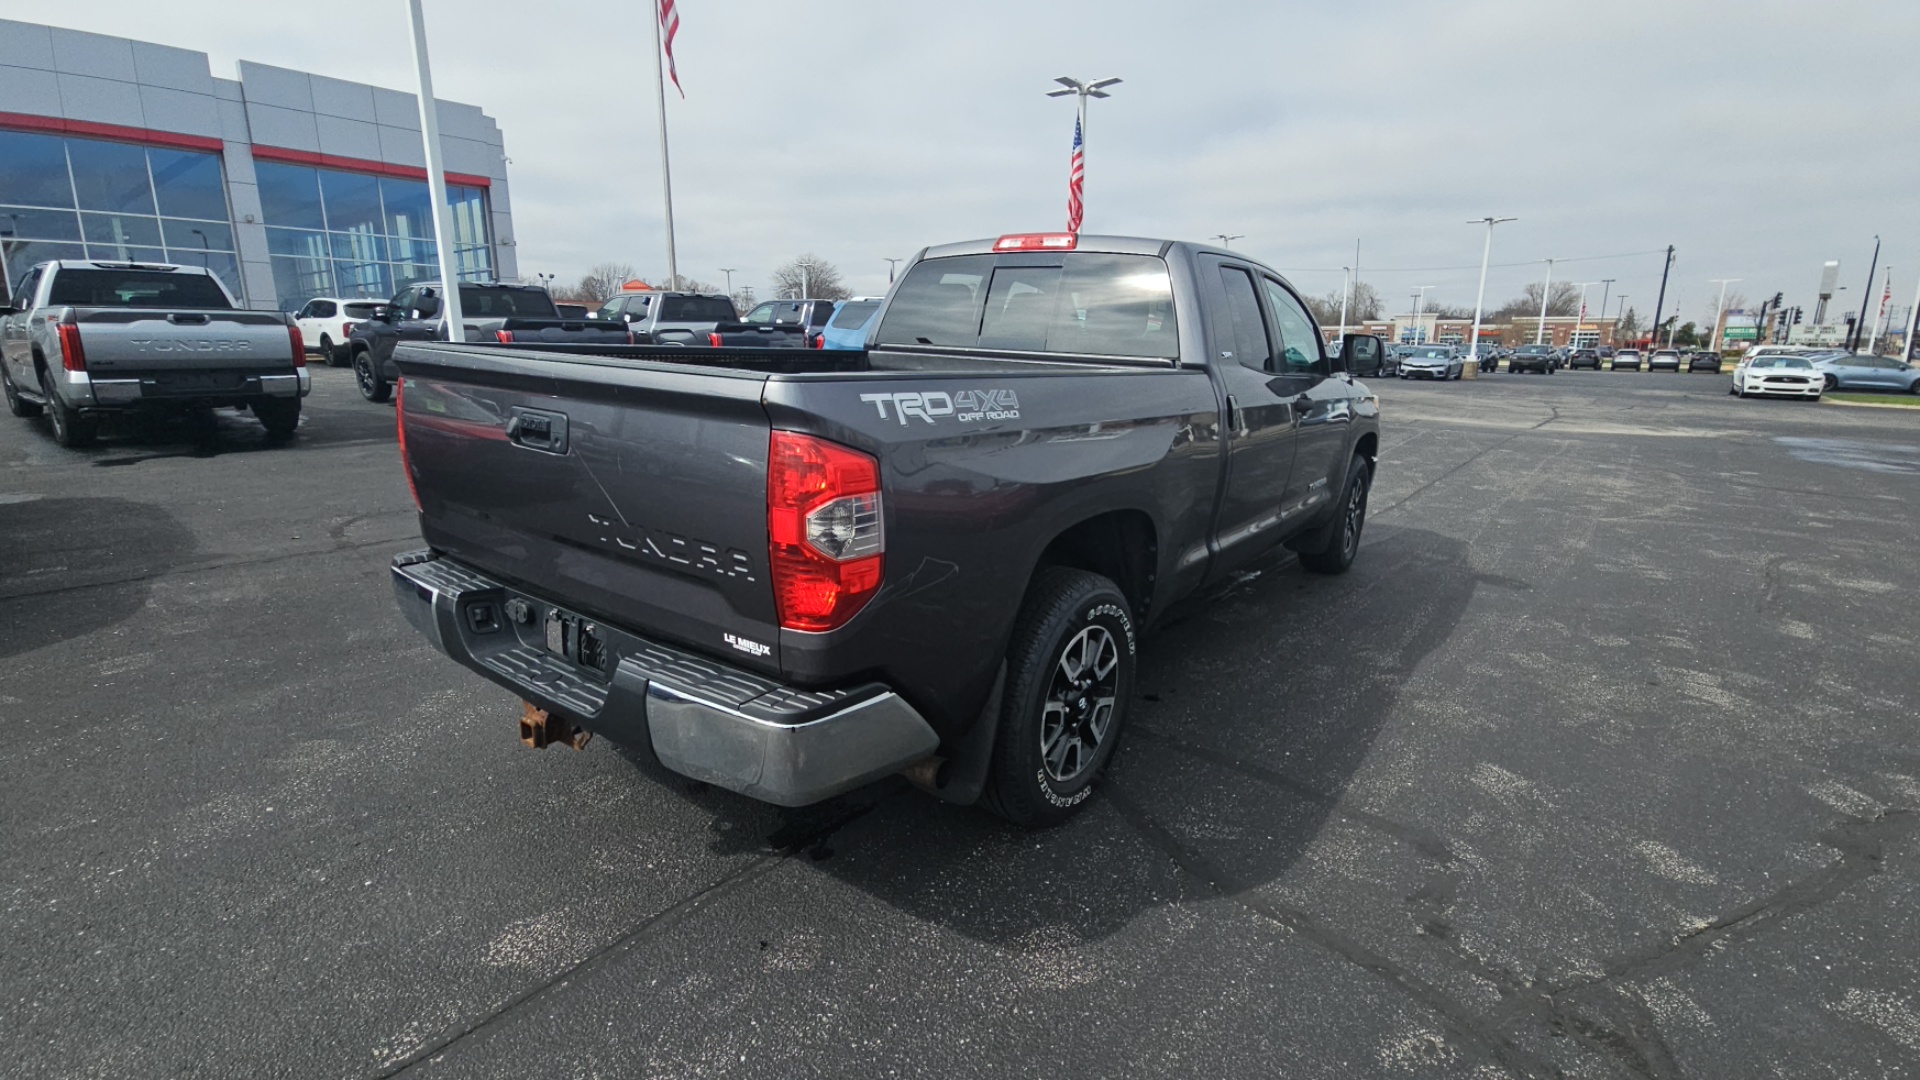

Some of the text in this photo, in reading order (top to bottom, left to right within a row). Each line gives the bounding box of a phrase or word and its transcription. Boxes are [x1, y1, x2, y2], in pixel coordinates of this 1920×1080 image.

[131, 339, 253, 352] TUNDRA
[859, 391, 955, 427] TRD
[958, 410, 1020, 422] OFF ROAD
[588, 513, 756, 581] TUNDRA
[723, 632, 737, 644] LE
[737, 637, 771, 656] MIEUX
[1087, 603, 1136, 655] GOODYEAR
[1037, 768, 1092, 808] WRANGLER
